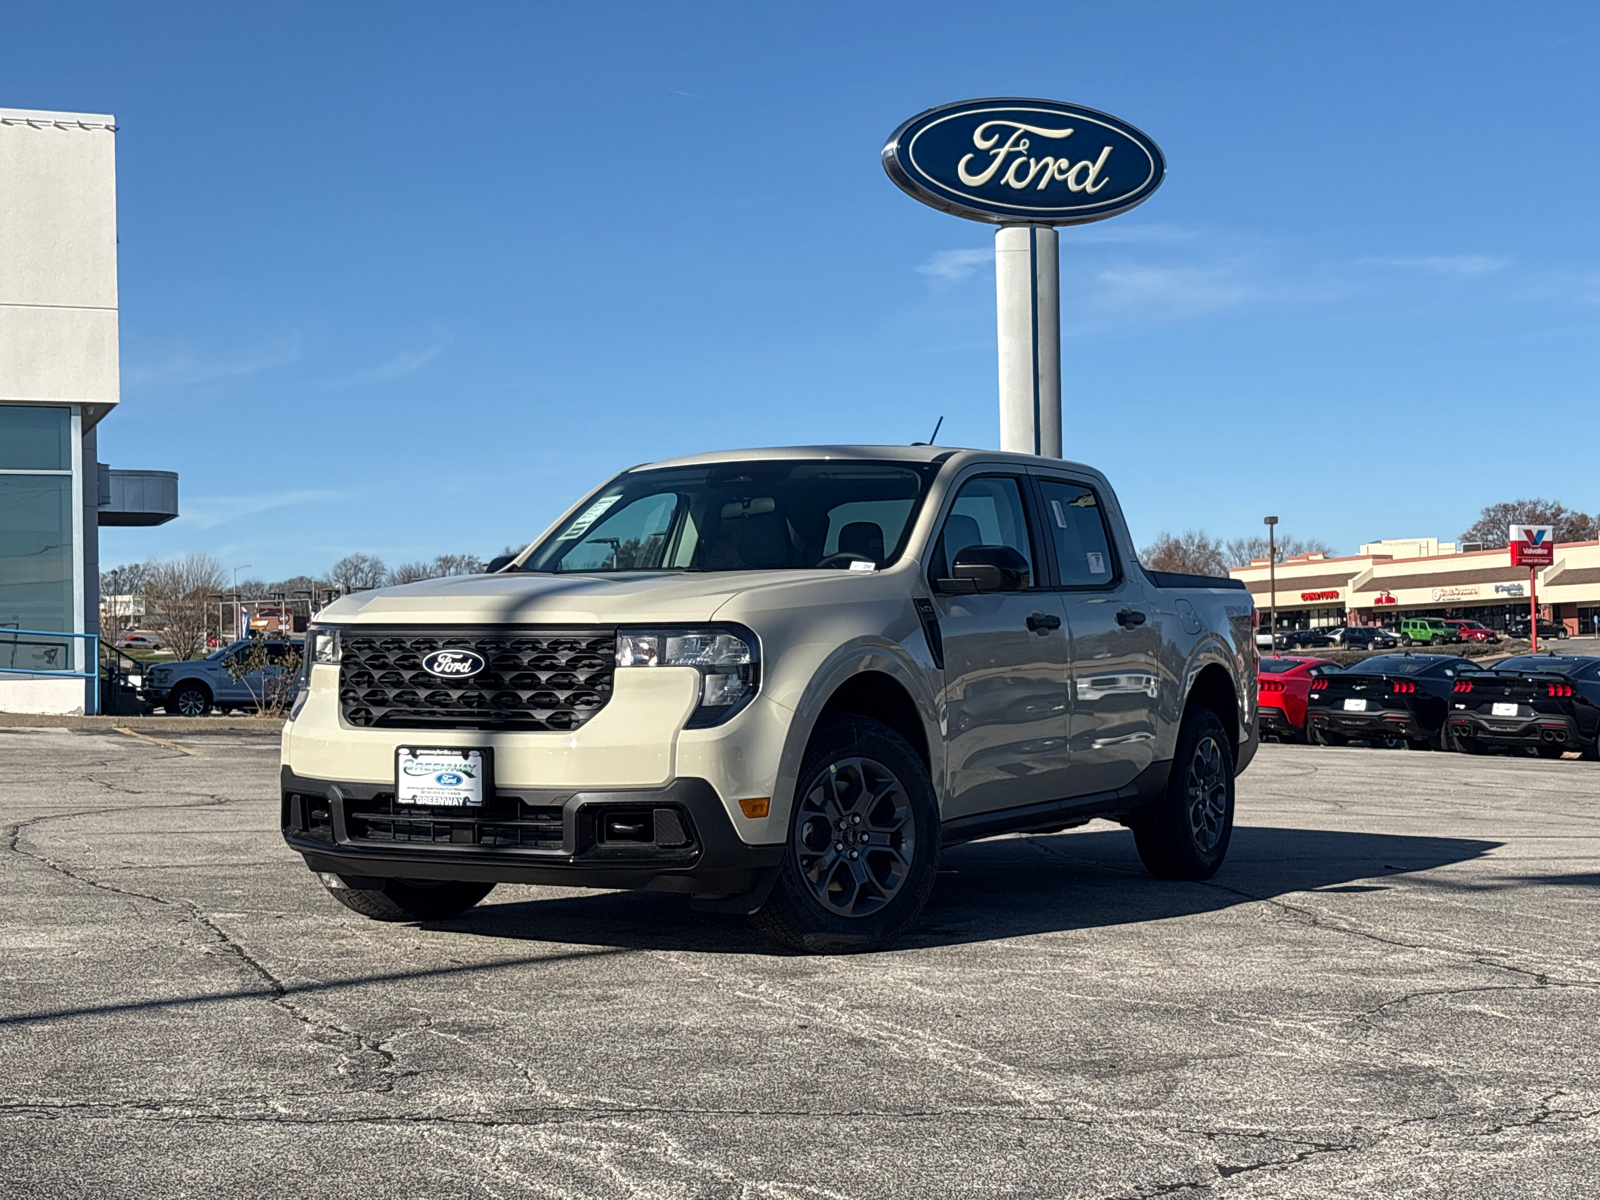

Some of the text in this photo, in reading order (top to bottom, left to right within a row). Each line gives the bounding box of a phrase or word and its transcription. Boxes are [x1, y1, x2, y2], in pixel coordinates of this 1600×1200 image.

[957, 120, 1114, 194] Ford
[1522, 547, 1549, 555] Valvoline
[433, 652, 472, 673] Ford
[403, 758, 477, 773] GREENWAY
[440, 774, 458, 784] Ford
[416, 796, 464, 806] GREENWAY
